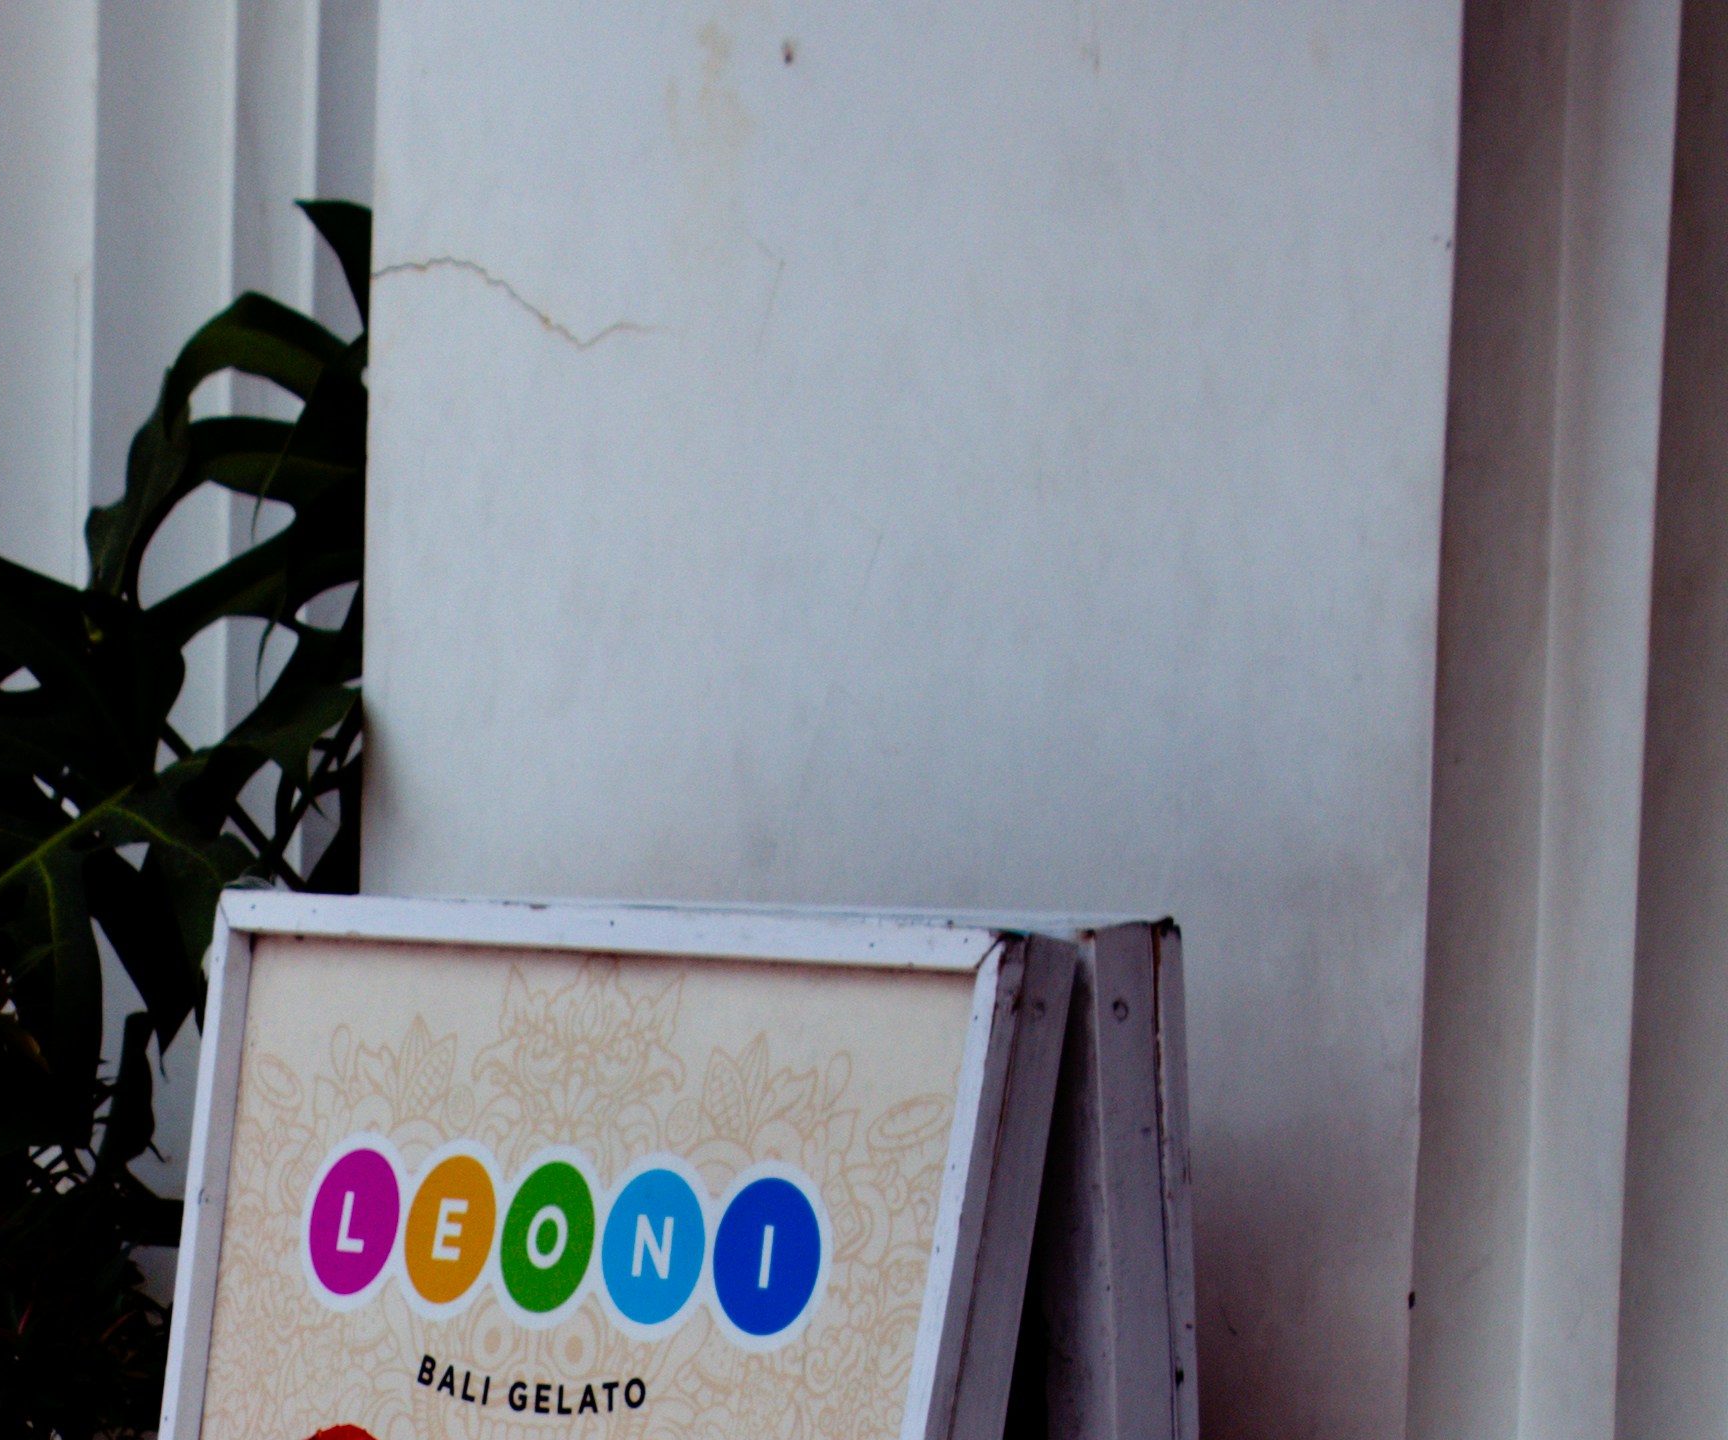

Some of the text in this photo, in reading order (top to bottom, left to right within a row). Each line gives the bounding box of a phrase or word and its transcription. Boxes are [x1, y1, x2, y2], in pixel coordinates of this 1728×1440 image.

[333, 1187, 777, 1293] LEONI
[417, 1354, 646, 1415] BALI GELATO
